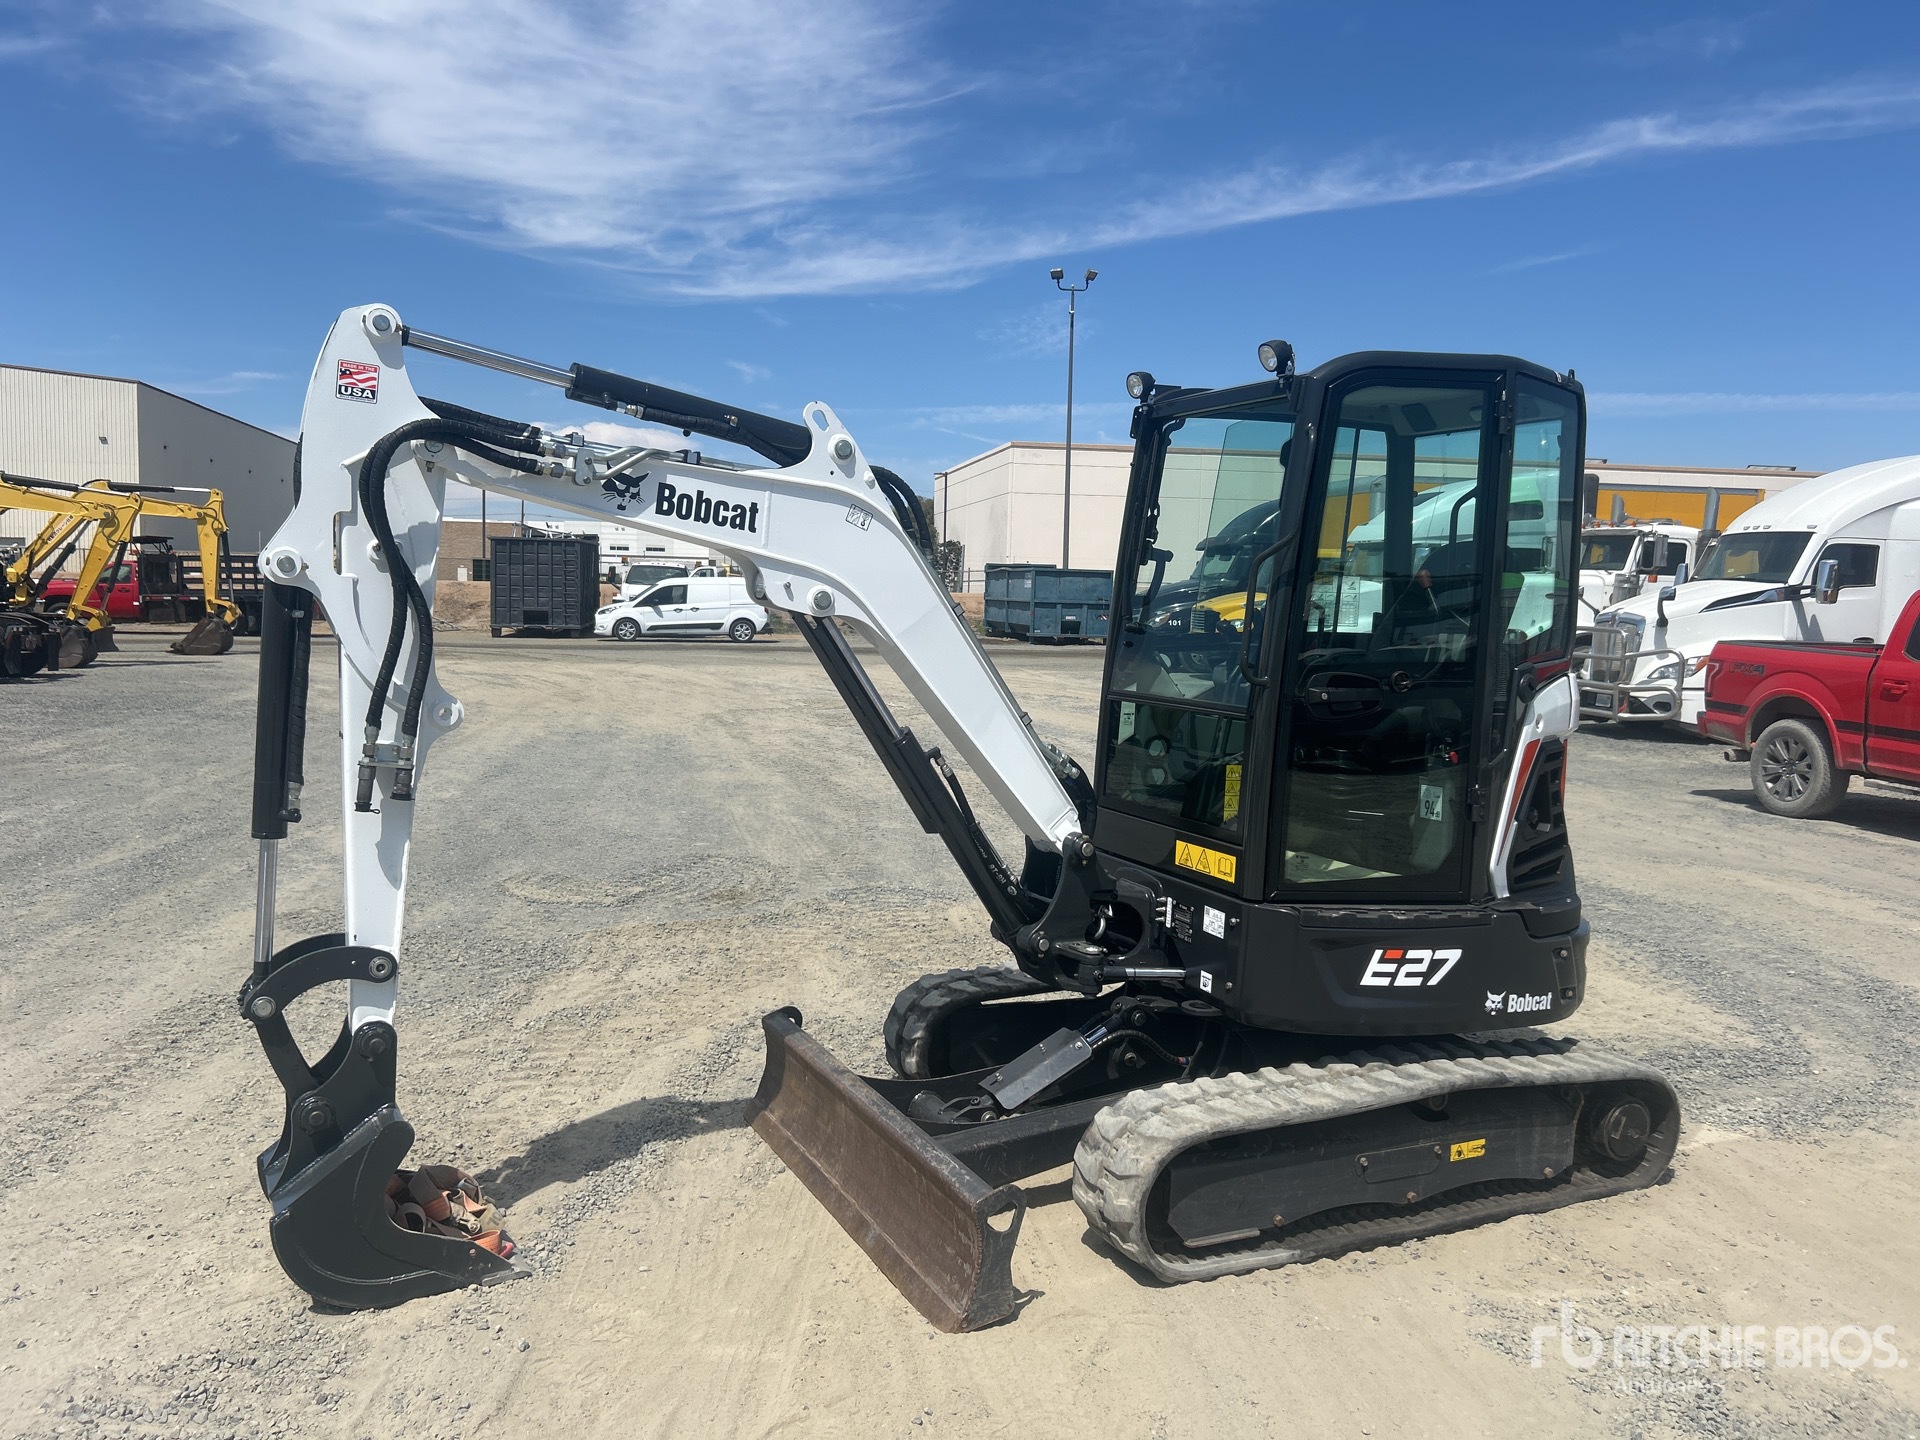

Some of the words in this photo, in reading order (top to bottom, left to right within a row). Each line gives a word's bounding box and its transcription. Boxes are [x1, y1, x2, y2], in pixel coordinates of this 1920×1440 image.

[341, 385, 373, 399] USA
[655, 481, 759, 533] Bobcat
[1729, 661, 1765, 676] FX4
[1424, 800, 1435, 817] 94
[1360, 949, 1462, 986] E27
[1507, 992, 1553, 1013] Bobcat
